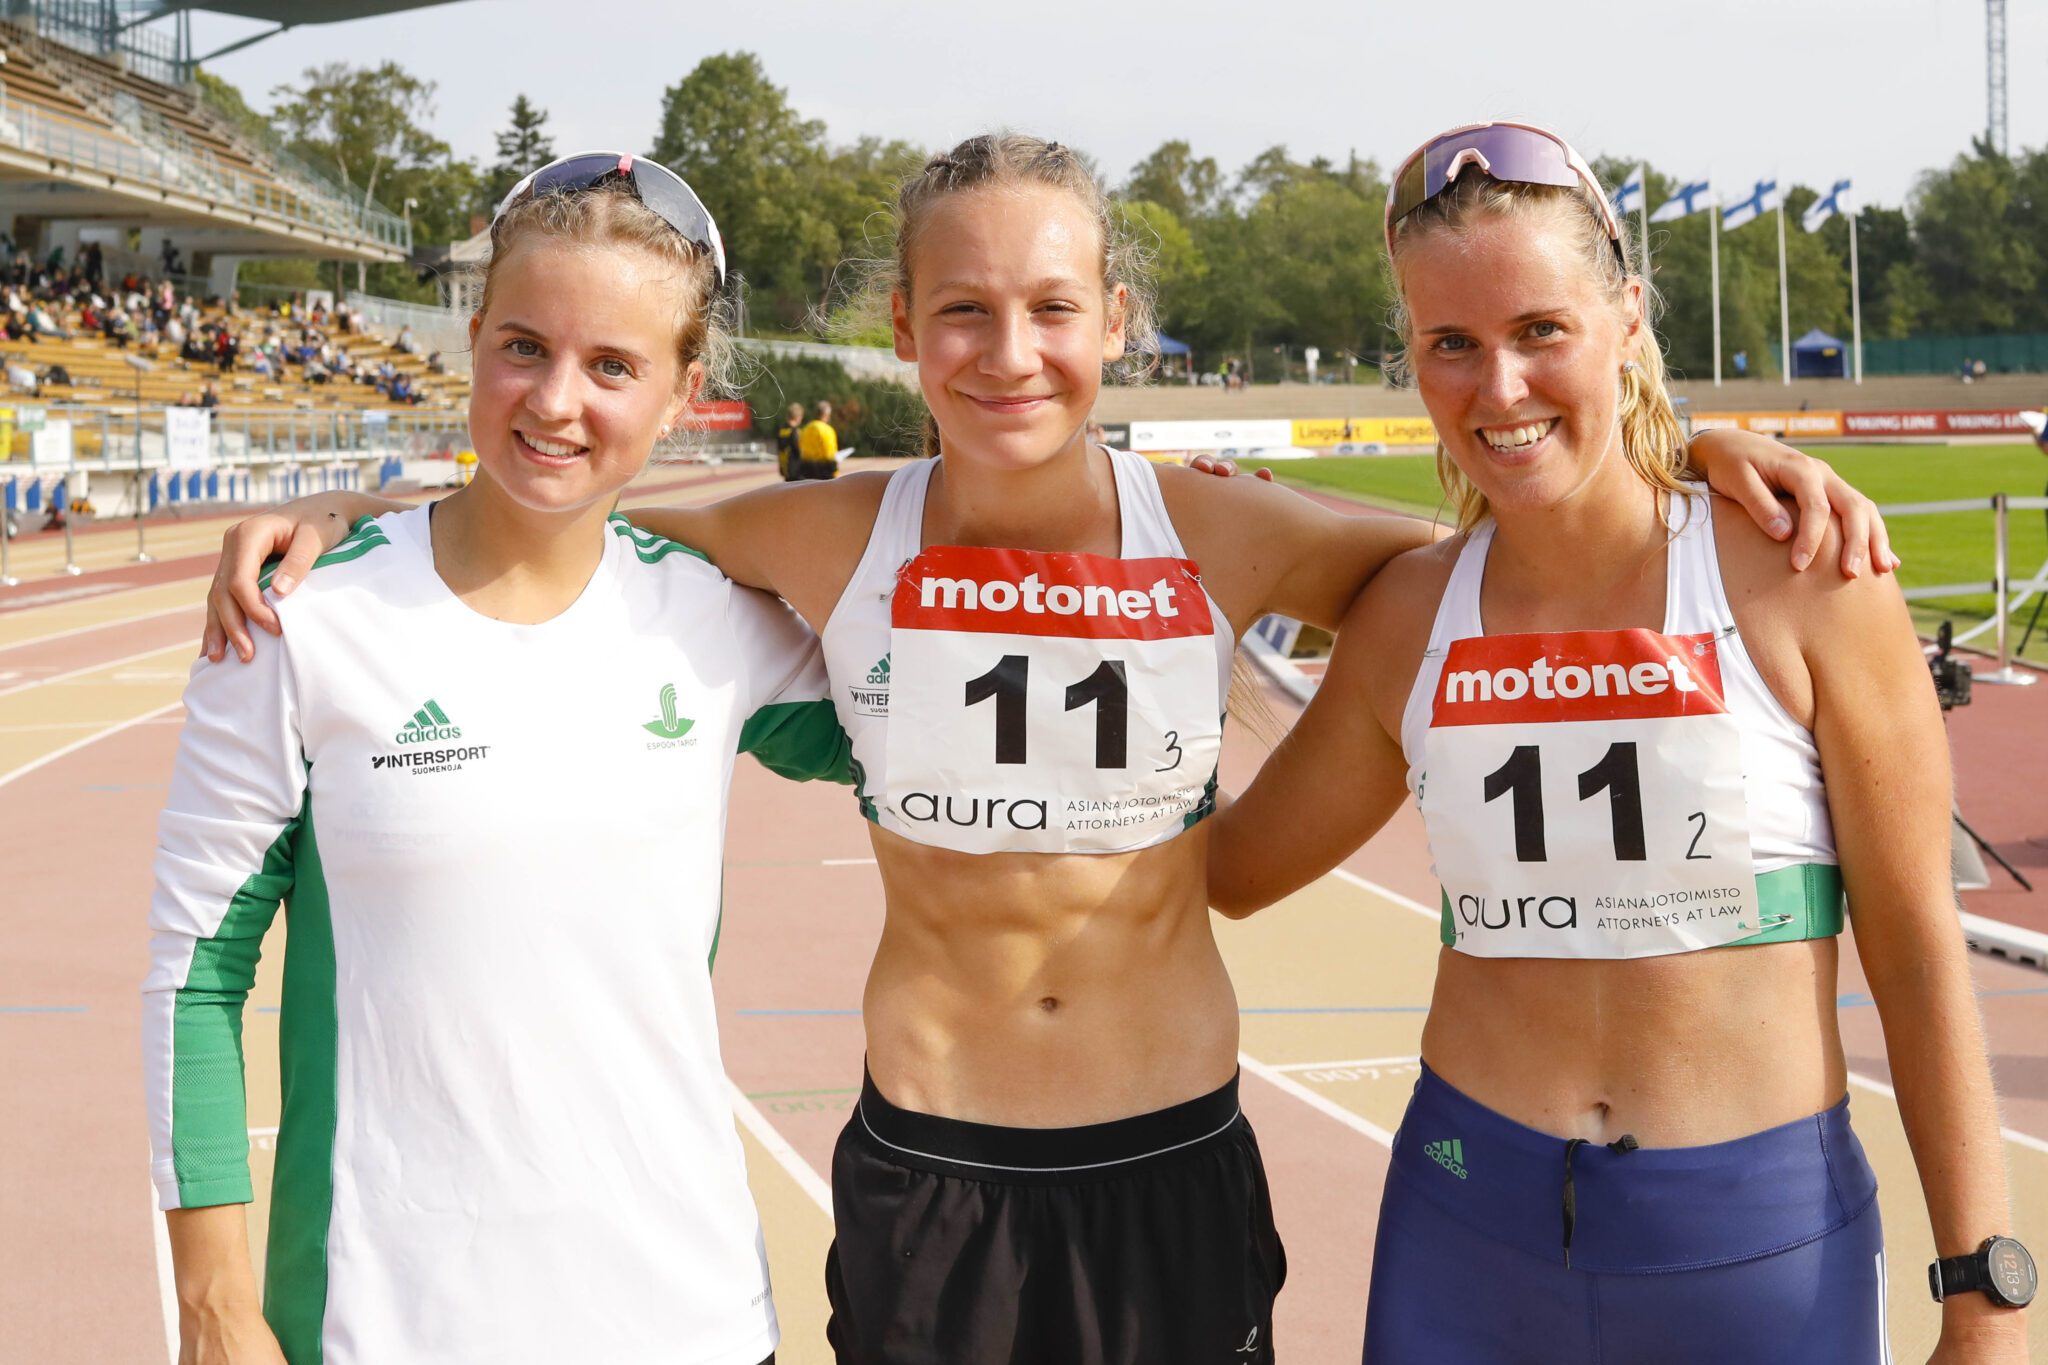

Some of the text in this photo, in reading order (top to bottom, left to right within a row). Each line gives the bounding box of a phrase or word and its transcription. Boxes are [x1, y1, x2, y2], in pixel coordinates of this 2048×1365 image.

[1847, 415, 1938, 430] VIKING LINE
[921, 572, 1179, 619] motonet
[1446, 655, 1699, 703] motonet
[965, 654, 1128, 769] 11
[395, 725, 462, 745] adidas
[646, 740, 676, 750] ESPOON
[1155, 730, 1183, 773] 3
[387, 745, 489, 768] INTERSPORT
[412, 763, 463, 775] SUOMENOJA
[900, 791, 1047, 831] aura
[1065, 798, 1195, 831] ATTORNEYS AT LAW
[1066, 784, 1196, 812] ASIANAJOTOIMISTO
[1484, 741, 1647, 862] 11
[1685, 811, 1712, 860] 2
[1458, 894, 1578, 930] aura
[1595, 887, 1741, 909] ASIANAJOTOIMISTO
[1596, 905, 1743, 931] ATTORNEYS AT LAW
[1423, 1144, 1469, 1180] adidas
